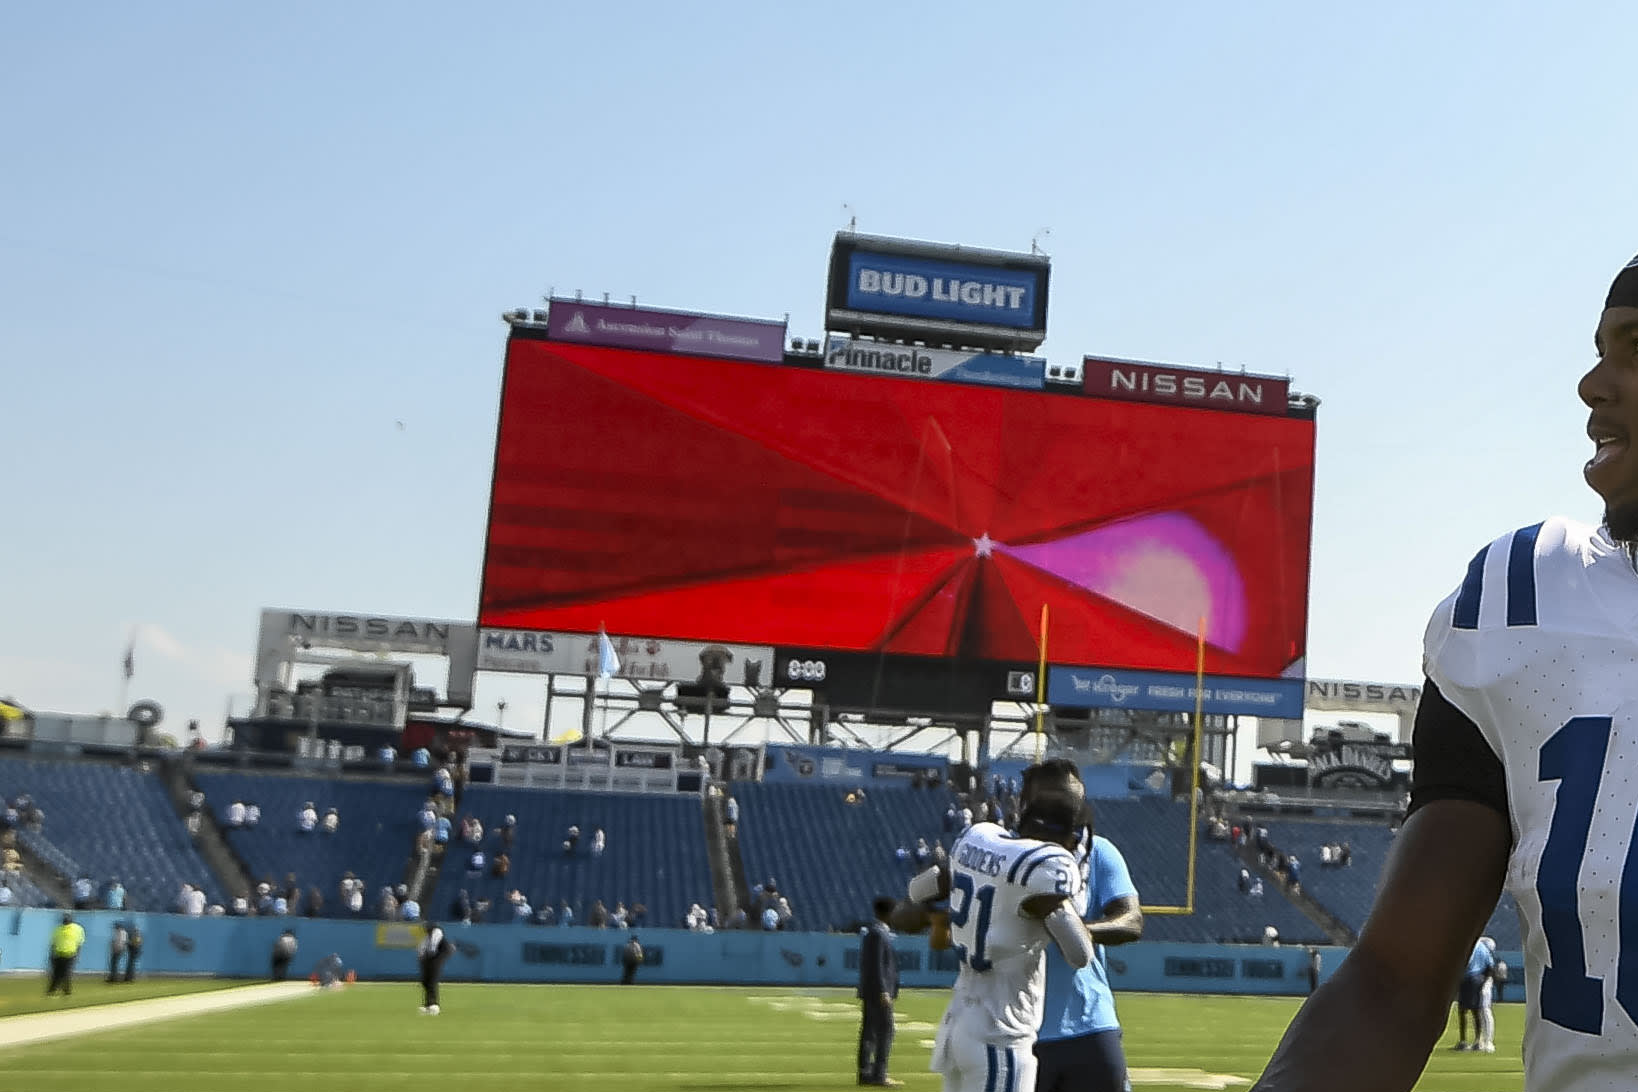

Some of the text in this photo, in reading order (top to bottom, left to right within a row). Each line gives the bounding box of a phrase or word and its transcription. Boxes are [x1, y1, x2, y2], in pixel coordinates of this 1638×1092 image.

[859, 268, 1024, 309] BUD LIGHT
[1111, 369, 1263, 403] NISSAN
[291, 613, 450, 640] NISSAN
[486, 633, 554, 653] MARS
[951, 871, 995, 972] 21
